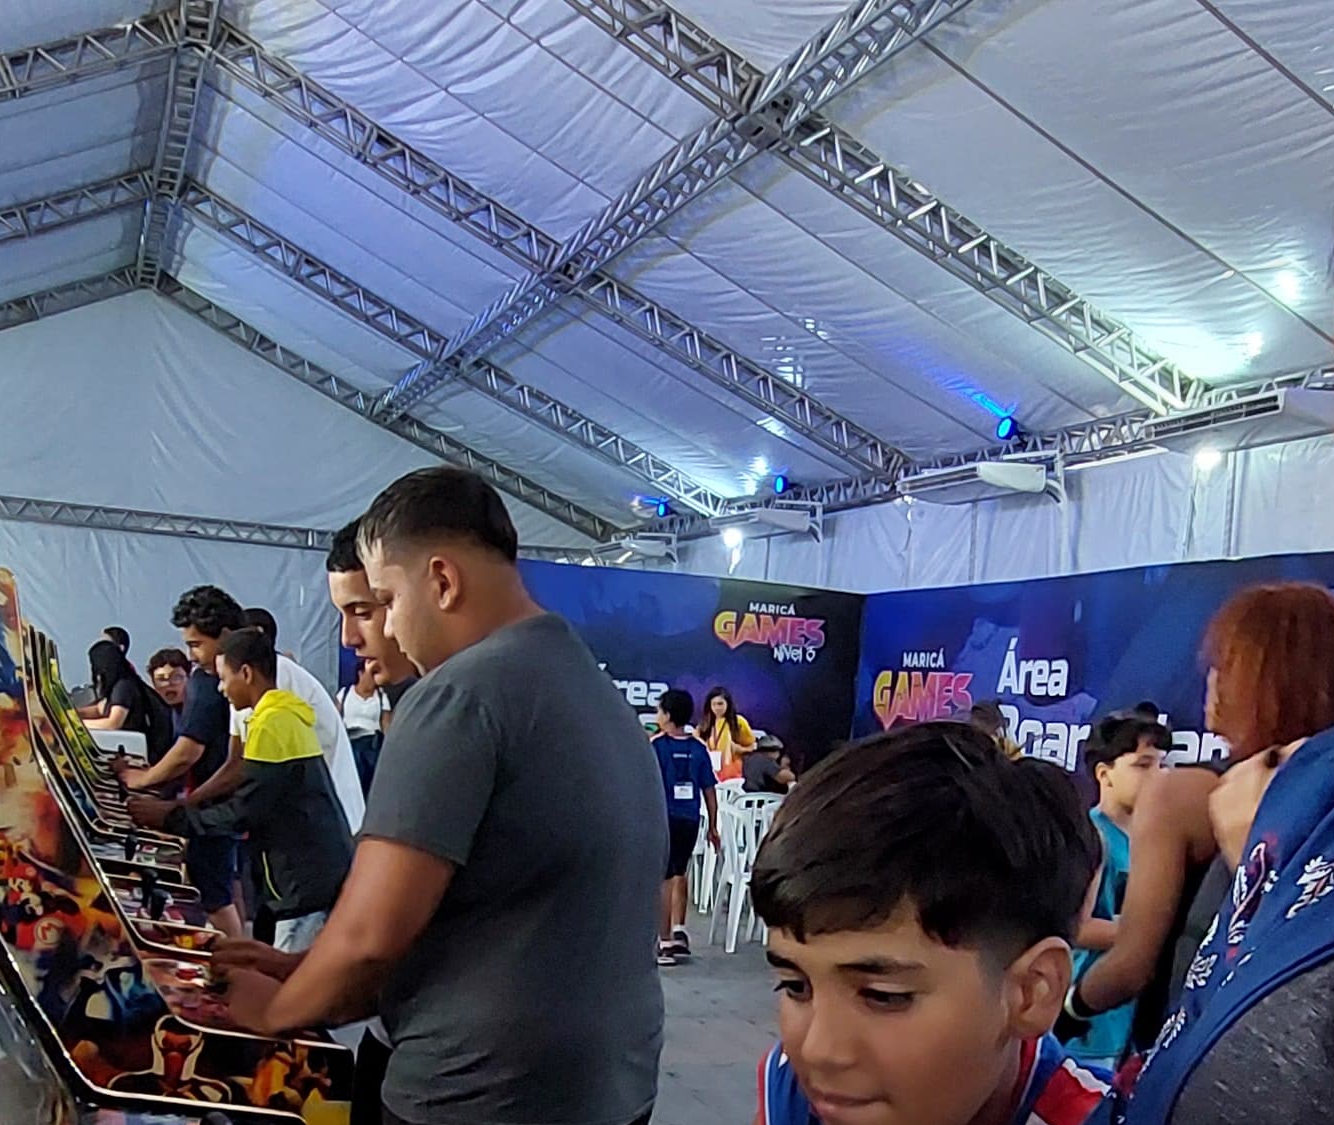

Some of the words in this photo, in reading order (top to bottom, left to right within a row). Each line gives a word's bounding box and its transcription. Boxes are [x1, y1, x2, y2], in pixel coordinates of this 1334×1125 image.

[749, 602, 796, 616] MARICÁ
[714, 610, 826, 649] GAMES
[902, 648, 945, 668] MARICÁ
[996, 637, 1069, 696] Área
[873, 671, 974, 730] GAMES
